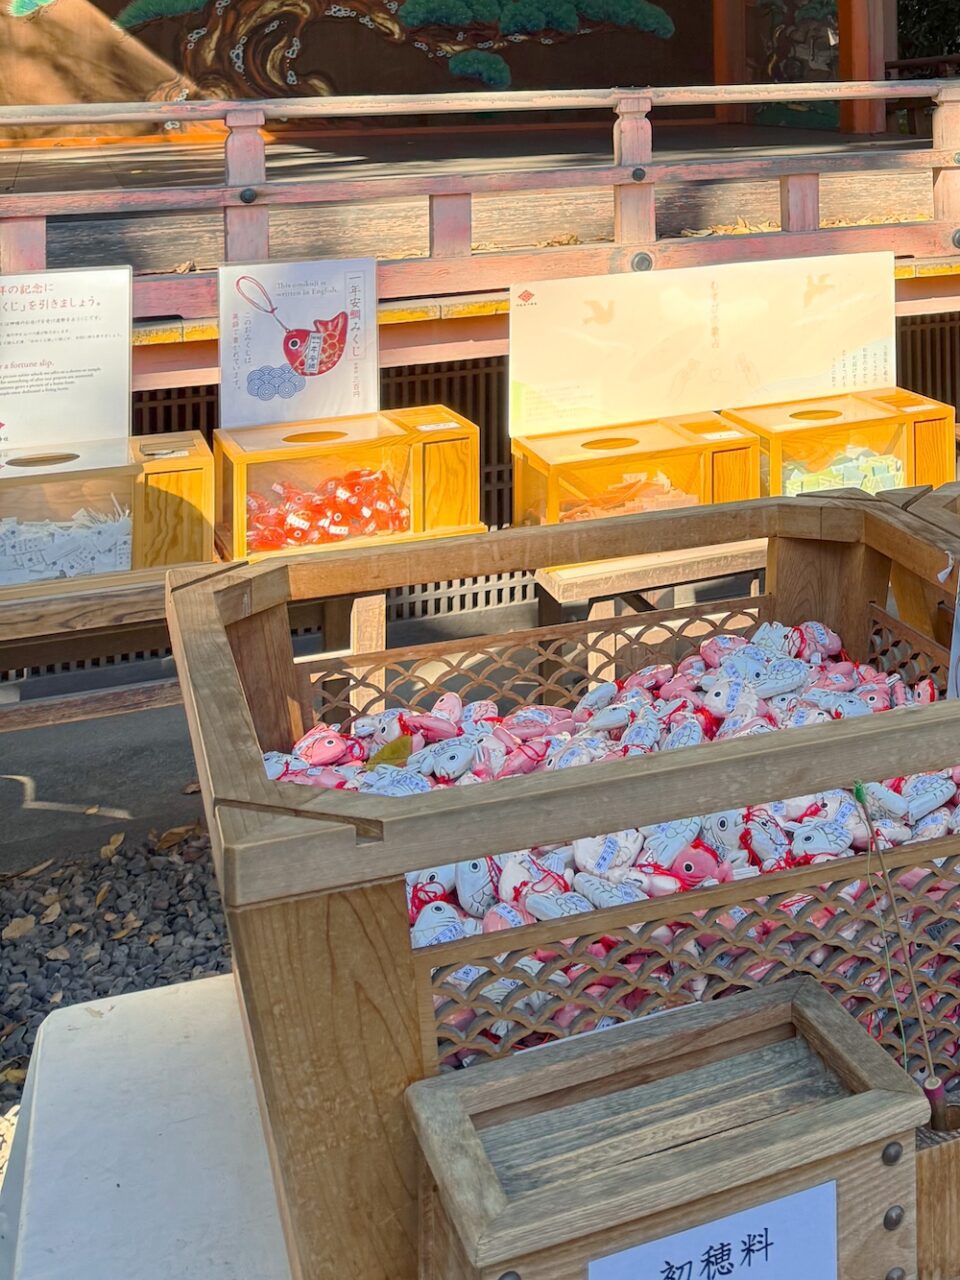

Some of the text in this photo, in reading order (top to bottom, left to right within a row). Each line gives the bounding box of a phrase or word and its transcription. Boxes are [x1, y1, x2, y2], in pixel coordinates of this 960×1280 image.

[348, 275, 361, 356] 一年安鯛みくじ
